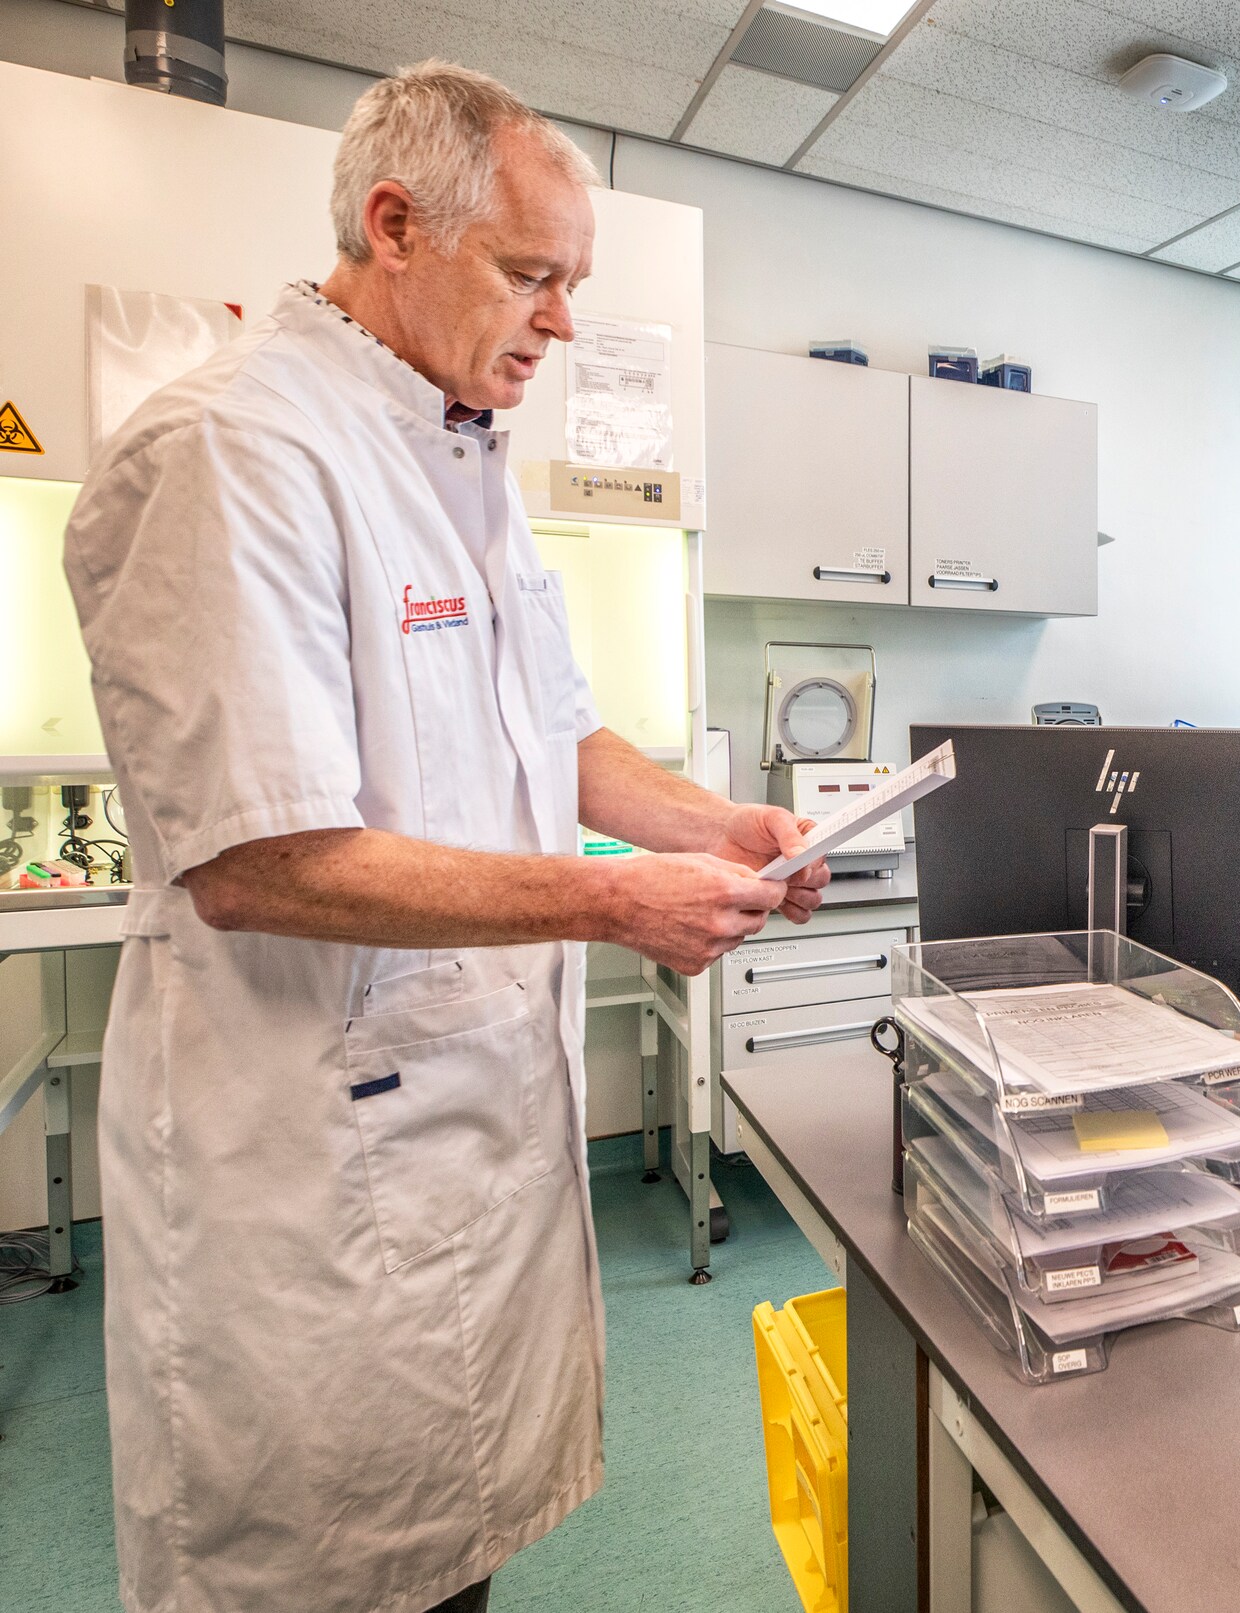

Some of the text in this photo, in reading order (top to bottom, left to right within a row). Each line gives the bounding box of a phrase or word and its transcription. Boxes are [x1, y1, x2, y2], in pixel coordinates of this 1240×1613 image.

[729, 945, 797, 957] MONSTERBUIZEN DOPPEN
[733, 987, 759, 996] NECSTAR
[986, 1005, 1039, 1016] PRIMERS
[746, 1019, 766, 1027] BUIZEN
[1208, 1068, 1225, 1080] PCR
[1005, 1094, 1078, 1108] NOG SCANNEN
[1050, 1193, 1094, 1204] FORMULIEREN
[1051, 1271, 1076, 1280] NIEUWE
[1052, 1279, 1082, 1289] INKLAREN
[1058, 1360, 1082, 1370] OVERIG
